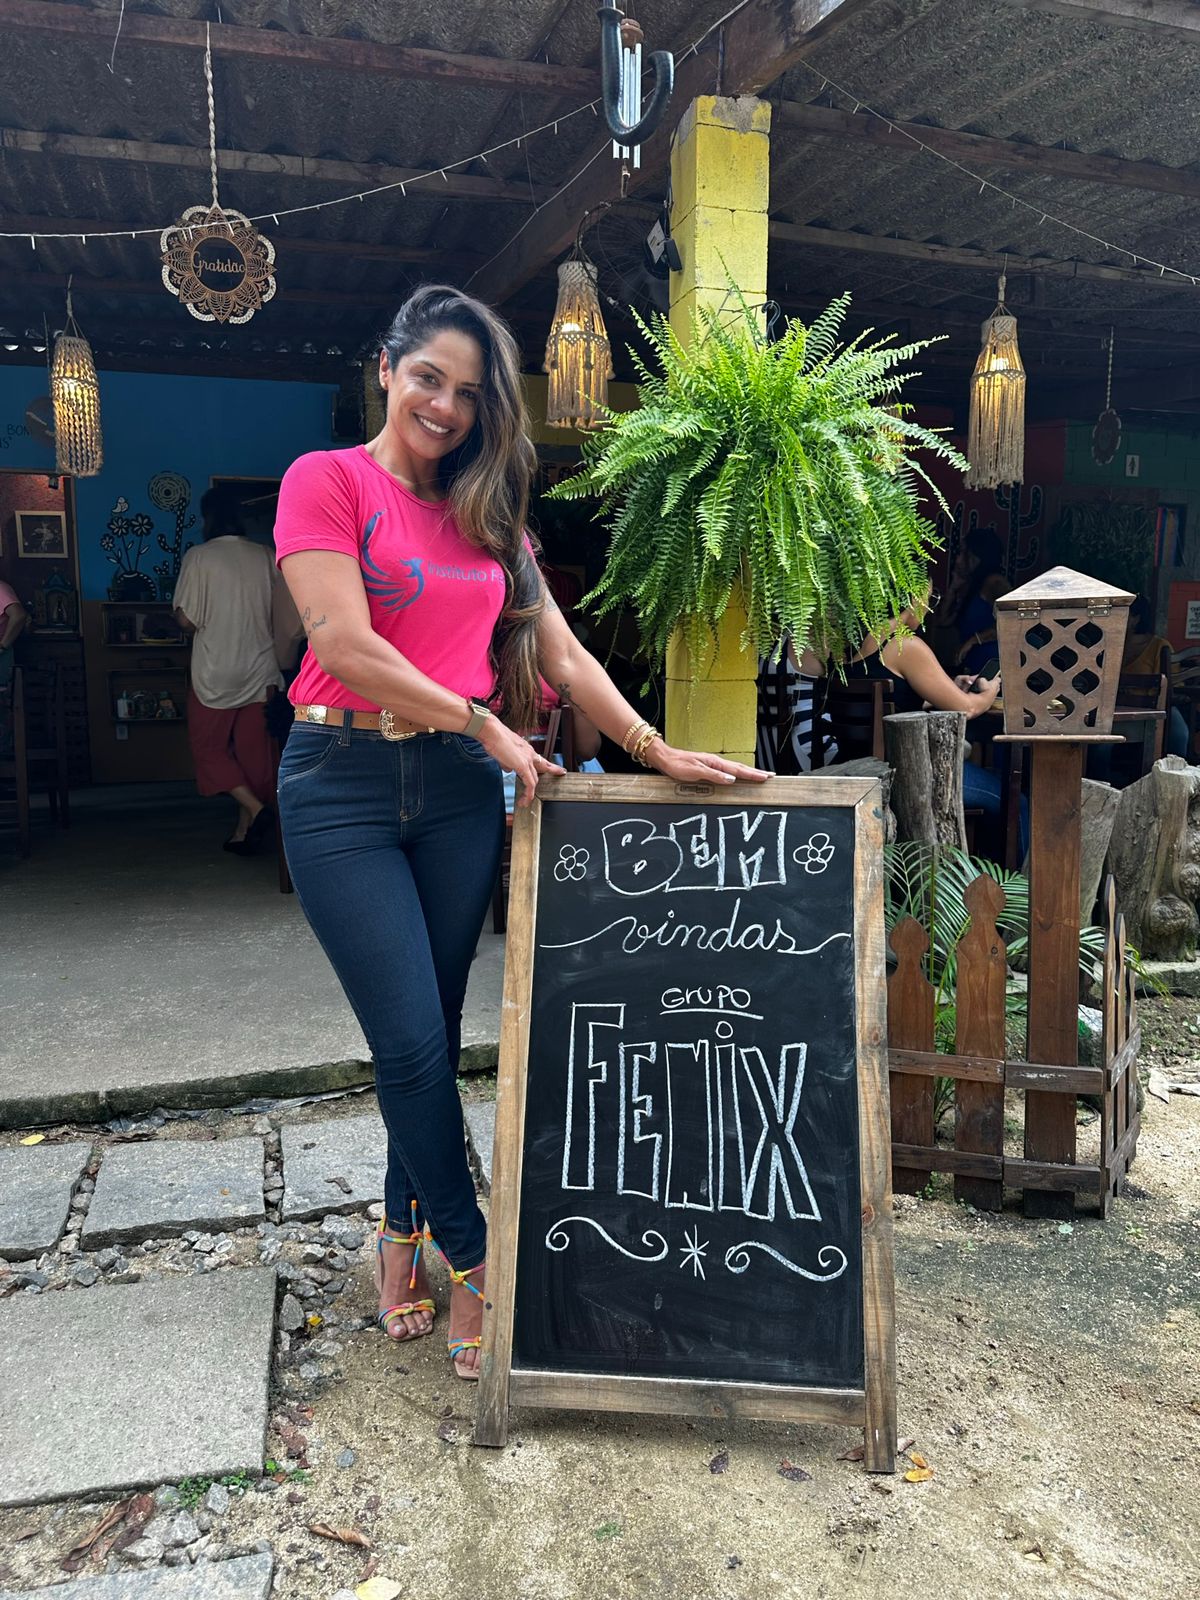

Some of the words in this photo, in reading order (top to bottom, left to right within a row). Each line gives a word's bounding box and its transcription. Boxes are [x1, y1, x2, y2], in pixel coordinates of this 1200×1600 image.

[428, 560, 488, 582] Instituto
[601, 811, 788, 896] BEM
[606, 897, 808, 955] vindas
